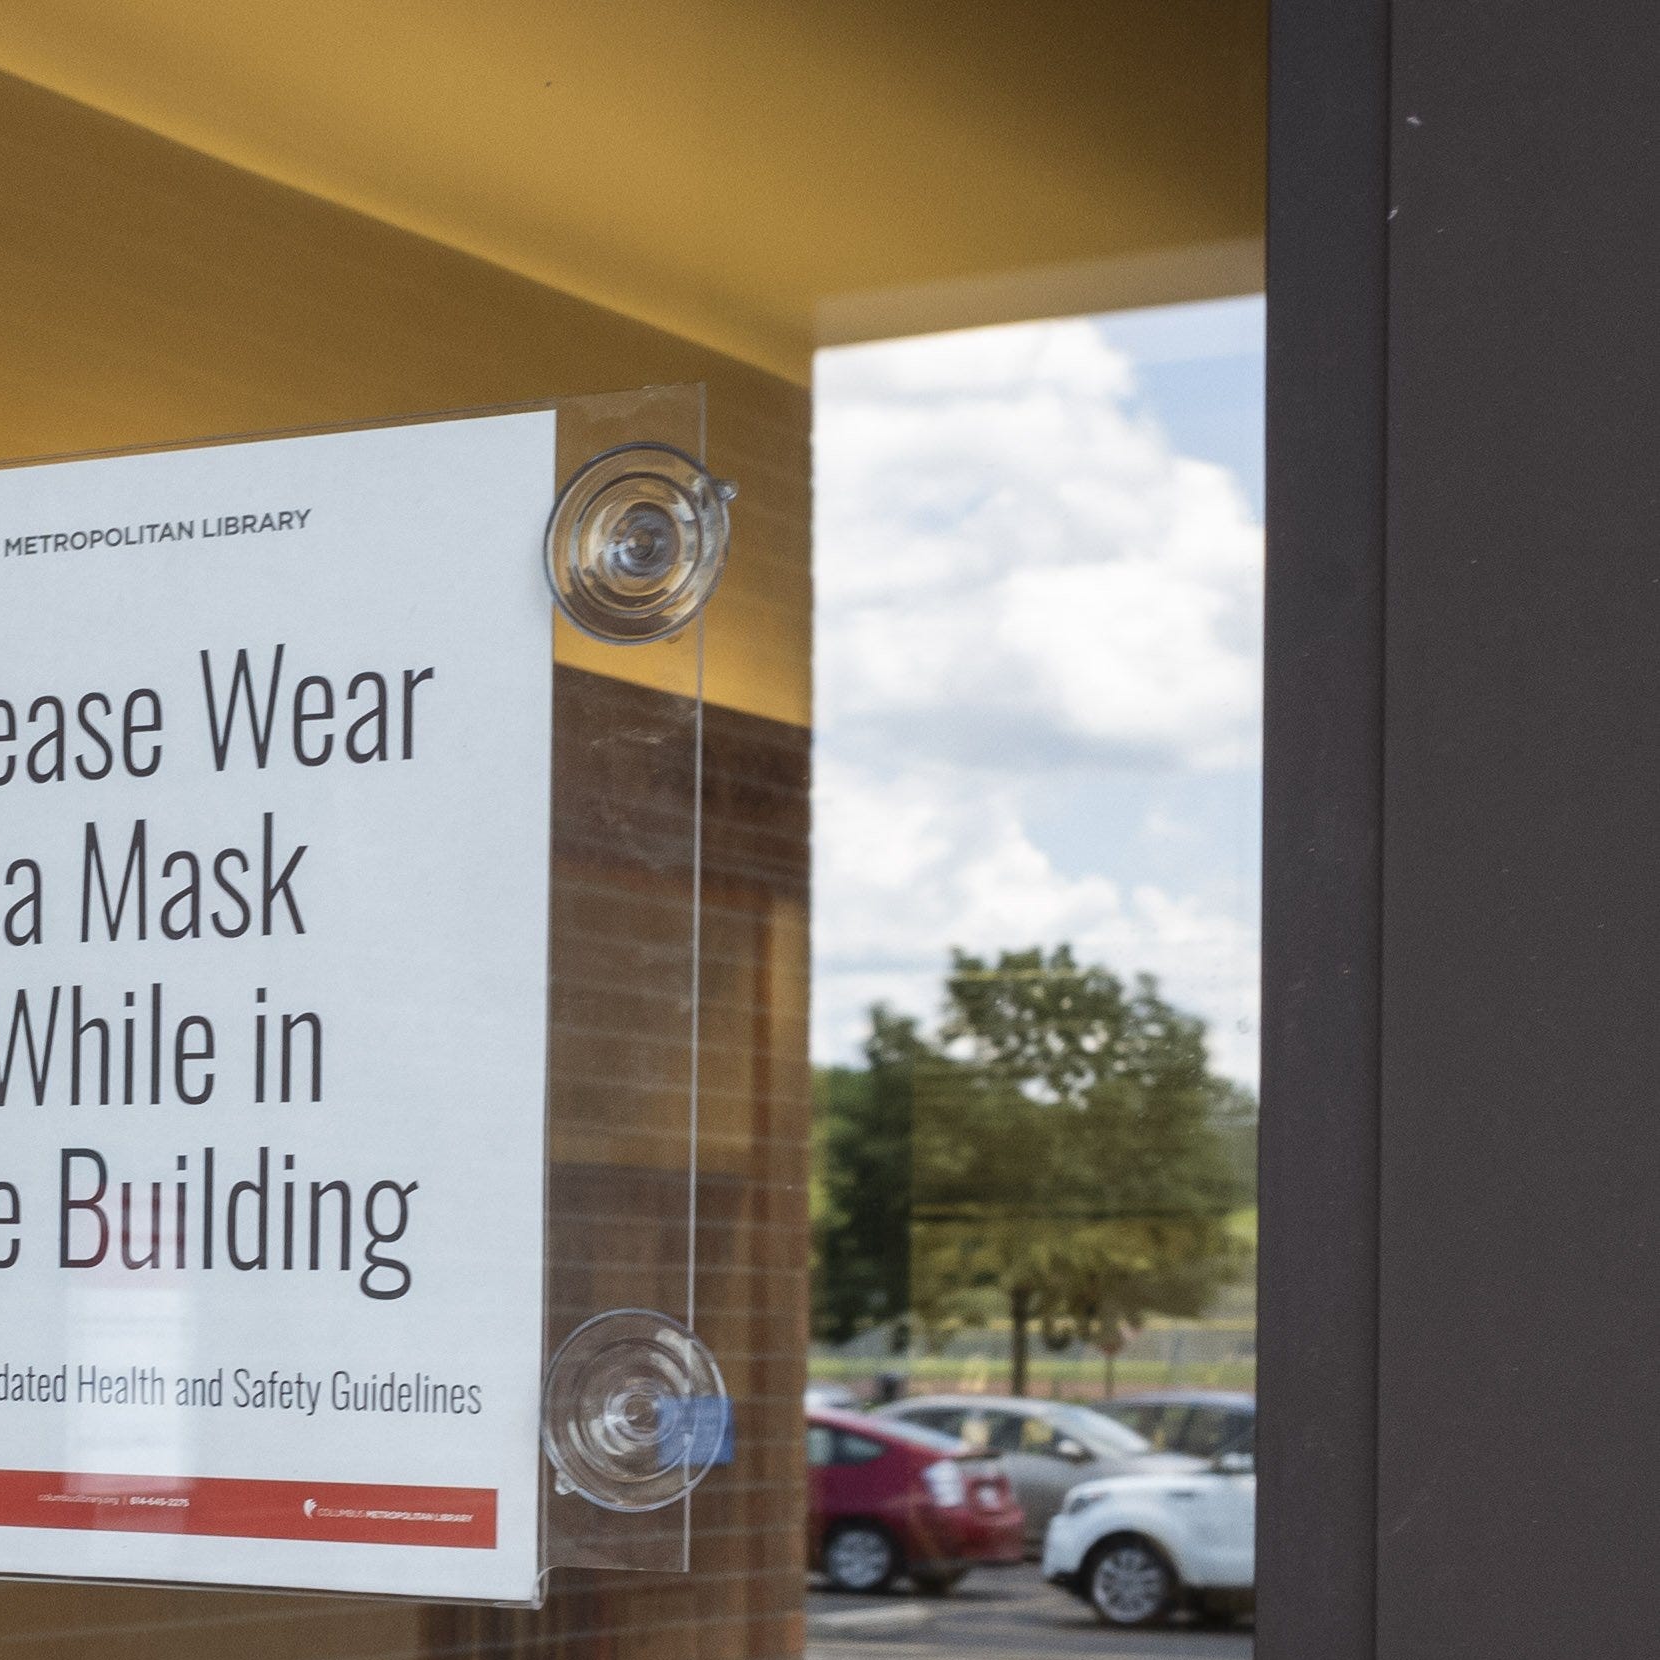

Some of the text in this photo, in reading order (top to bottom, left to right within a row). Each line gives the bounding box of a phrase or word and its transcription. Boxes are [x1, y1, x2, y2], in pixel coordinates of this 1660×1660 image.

[3, 519, 196, 558] METROPOLITAN
[201, 508, 312, 539] LIBRARY
[199, 643, 435, 772] Wear
[3, 811, 309, 947] a Mask
[254, 987, 322, 1104] in
[59, 1146, 419, 1301] Building
[77, 1364, 165, 1406] Health
[175, 1367, 224, 1408] and
[233, 1368, 322, 1416] Safety
[331, 1370, 483, 1415] Guidelines
